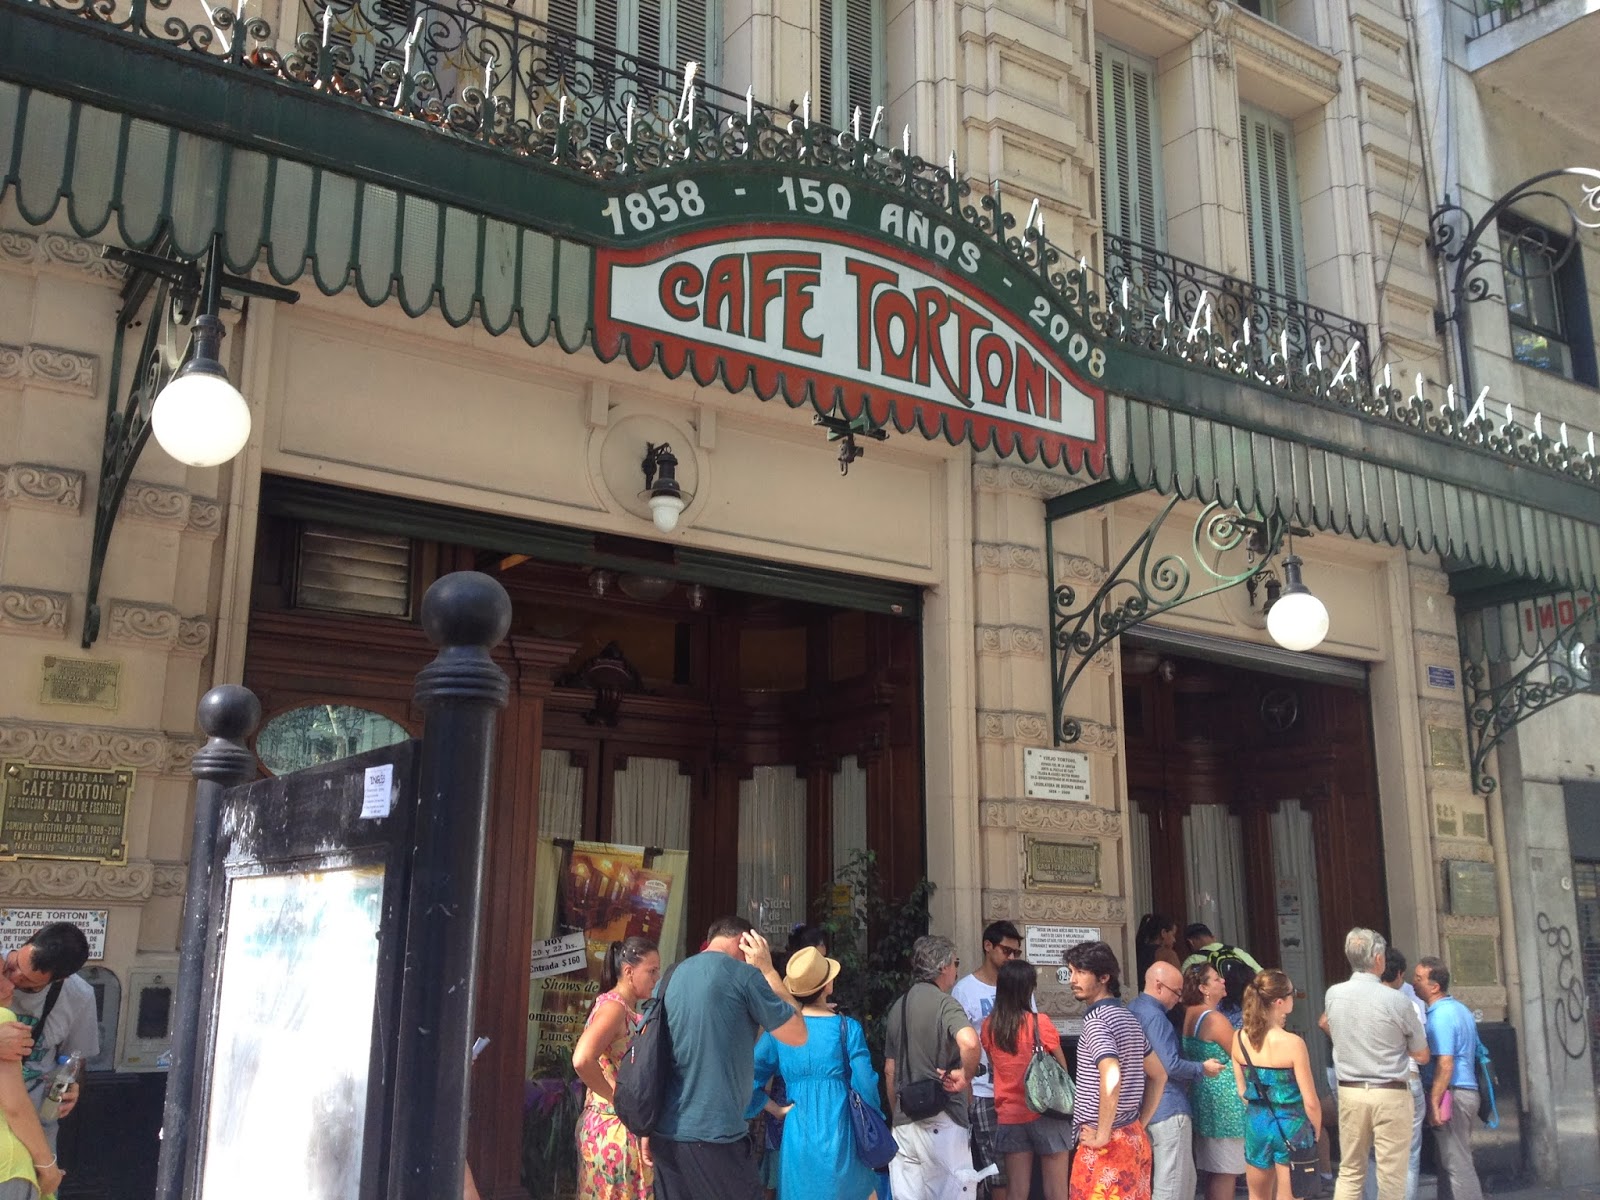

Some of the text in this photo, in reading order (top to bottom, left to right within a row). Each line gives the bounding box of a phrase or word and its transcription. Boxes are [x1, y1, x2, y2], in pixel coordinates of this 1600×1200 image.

[600, 178, 706, 236] 1858
[777, 175, 853, 221] 150
[878, 202, 983, 275] AÑOS
[1027, 294, 1109, 380] 2008
[658, 249, 1063, 425] CAFE TORTONI
[33, 770, 105, 783] HOMENAJE AL
[17, 797, 46, 810] SOCIEDAD
[47, 799, 79, 813] ARGENTINA
[80, 801, 88, 813] DE
[89, 801, 122, 815] ESCRITORES
[33, 822, 62, 833] DIRECTIVA
[64, 824, 89, 834] PERIODO
[13, 831, 21, 840] EN
[23, 832, 31, 841] EL
[34, 832, 74, 843] ANIVERSARIO
[76, 834, 83, 843] DE
[85, 835, 92, 844] LA
[763, 897, 791, 909] Sidra
[17, 911, 88, 920] CAFE TORTONI
[768, 910, 780, 921] de
[544, 937, 563, 947] HOY
[532, 949, 542, 957] 20
[530, 961, 559, 973] Entrada
[541, 977, 599, 993] Shows de
[528, 1011, 578, 1025] omingos:
[540, 1030, 574, 1042] Lunes
